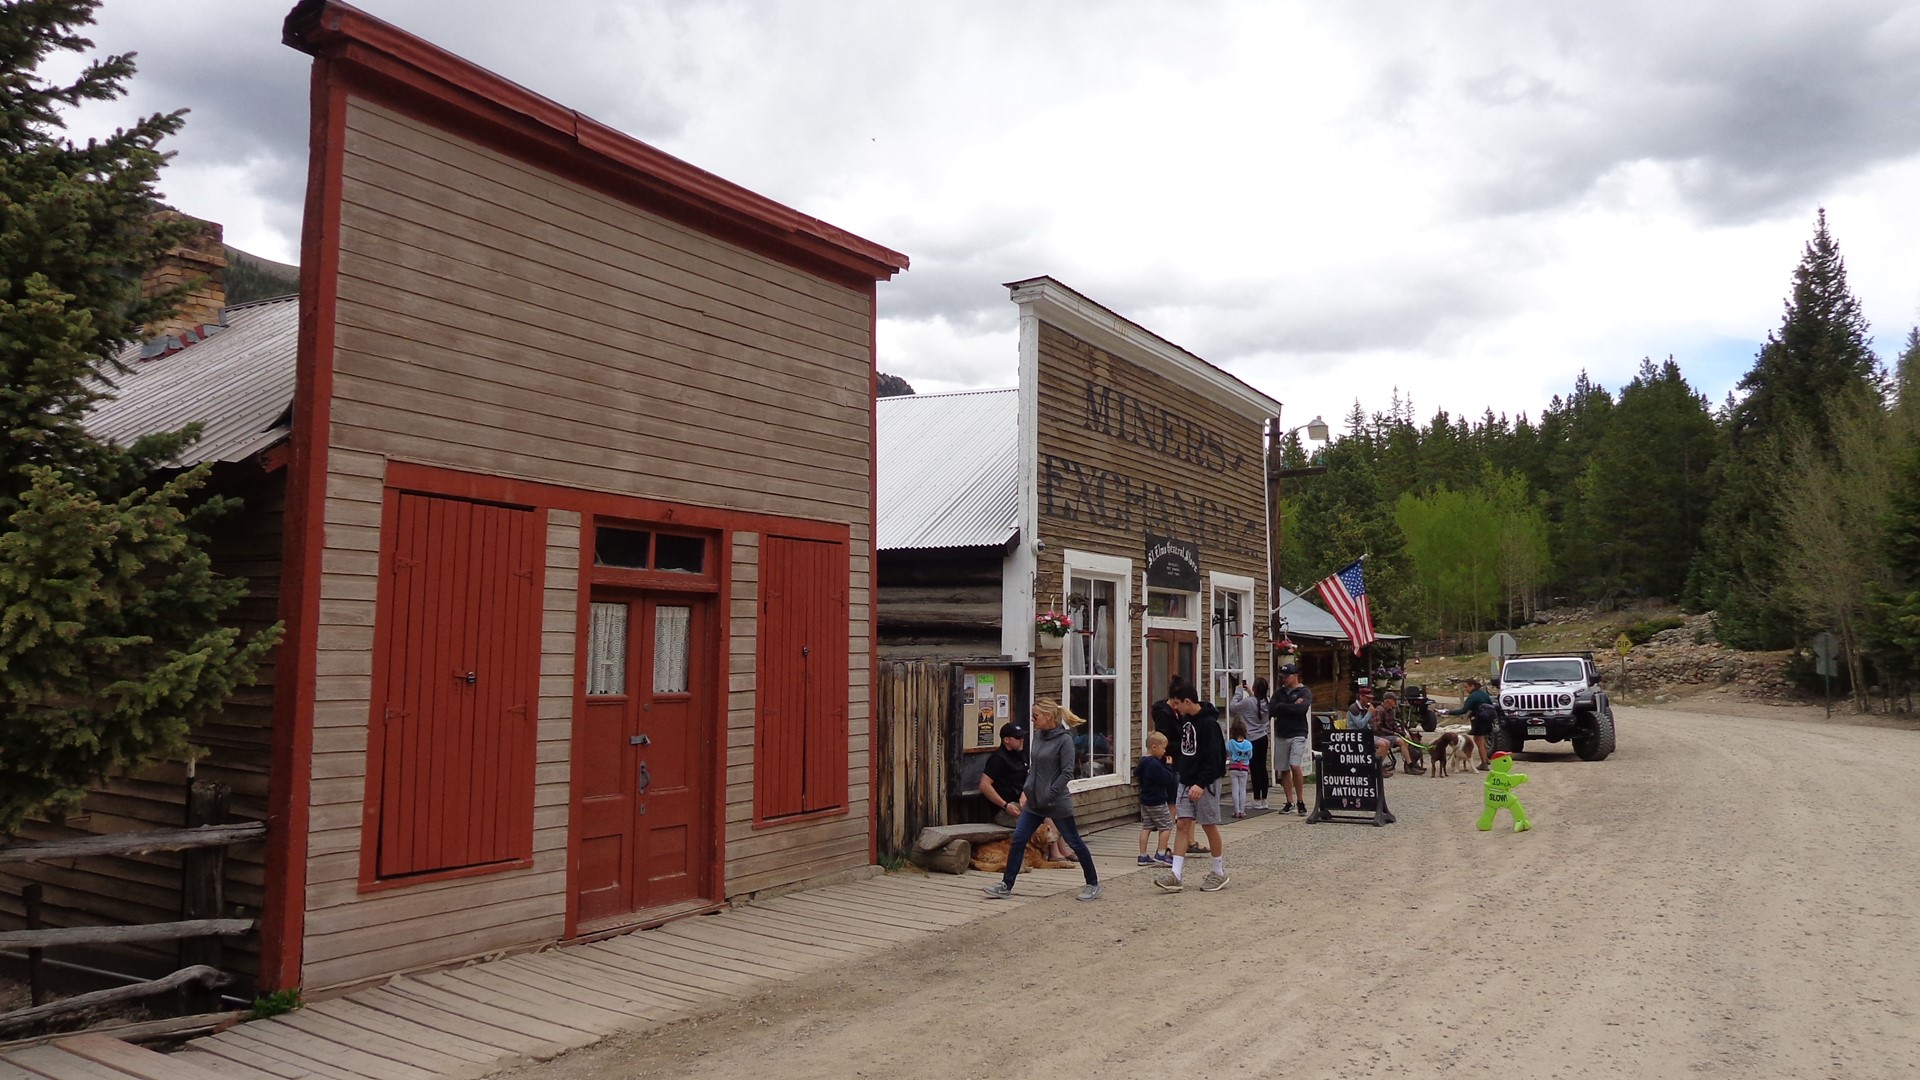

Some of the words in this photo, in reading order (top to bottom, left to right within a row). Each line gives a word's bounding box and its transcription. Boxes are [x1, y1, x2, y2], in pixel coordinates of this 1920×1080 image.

[1083, 380, 1226, 474] MINERS
[1045, 454, 1259, 558] EXCHANGE
[1167, 541, 1185, 558] General
[1184, 550, 1197, 573] Store
[1617, 640, 1629, 648] DIP
[1330, 732, 1363, 742] COFFEE
[1334, 743, 1364, 753] COLD
[1340, 754, 1372, 764] DRINKS
[1323, 775, 1369, 786] SOUVENIRS
[1331, 787, 1375, 797] ANTIQUES
